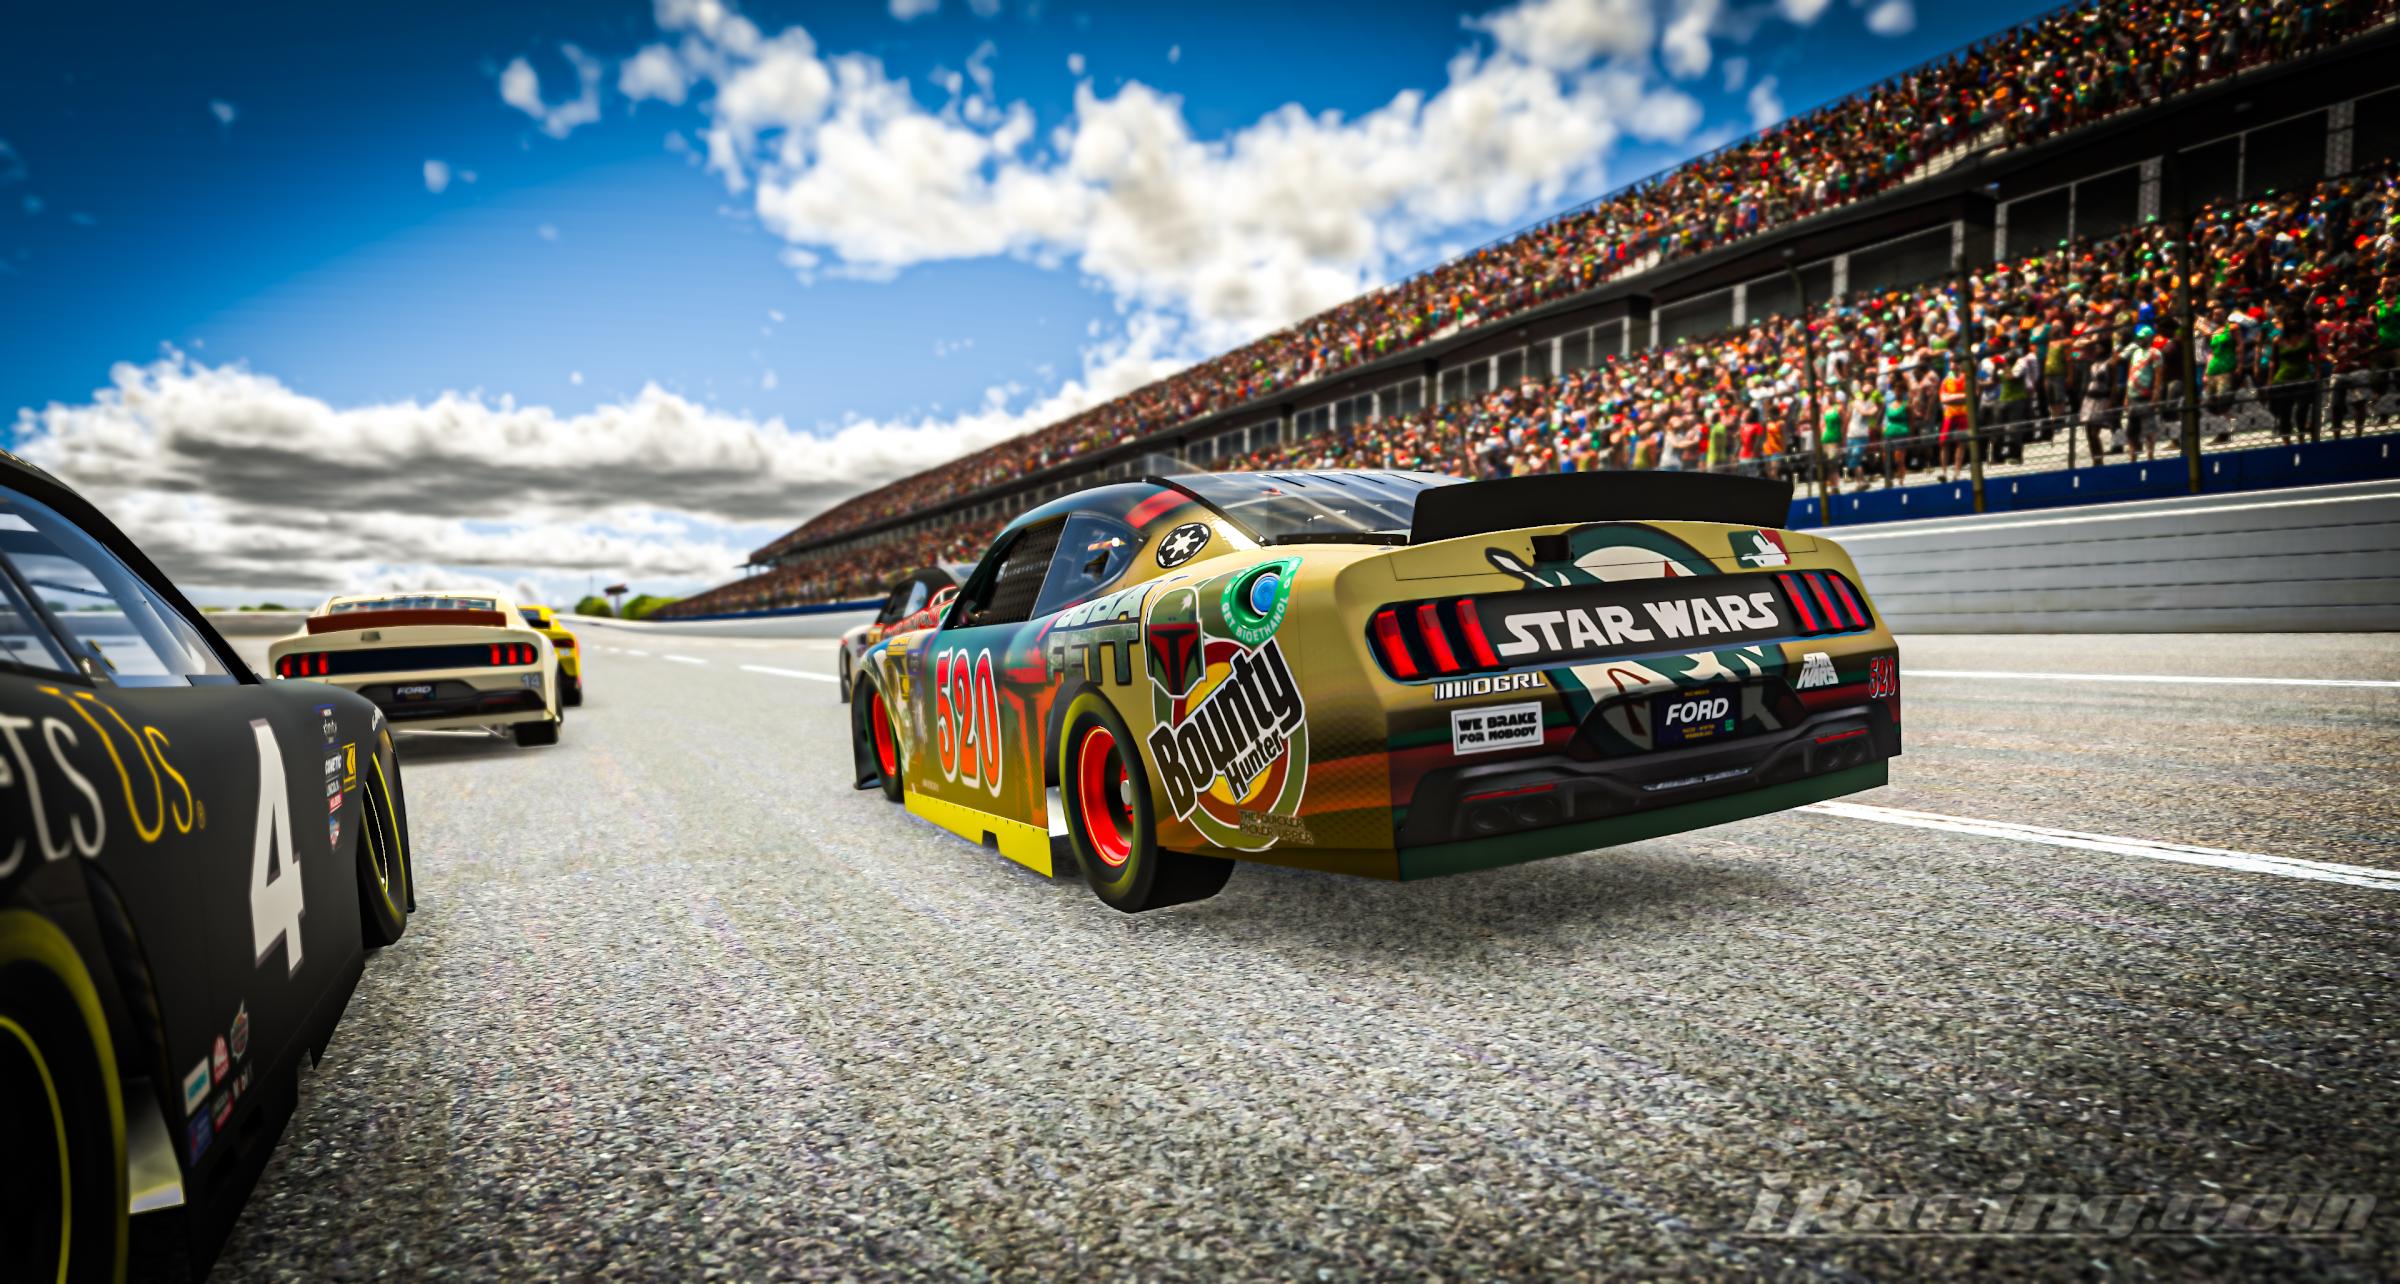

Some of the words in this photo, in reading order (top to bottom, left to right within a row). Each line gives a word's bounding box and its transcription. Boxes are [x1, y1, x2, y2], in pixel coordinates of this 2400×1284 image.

[1221, 602, 1236, 628] GET
[1235, 597, 1289, 642] BIOETHANOL
[1497, 609, 1654, 656] STAR
[1642, 591, 1779, 639] WARS
[1046, 622, 1140, 686] FETT
[397, 686, 432, 696] FORD
[1796, 667, 1839, 689] WARS
[1869, 656, 1896, 698] 520
[936, 647, 1003, 798] 520
[1147, 636, 1305, 822] Bounty
[1458, 718, 1482, 731] WE
[1487, 712, 1537, 729] BRAKE
[1665, 697, 1729, 726] FORD
[1459, 732, 1484, 745] FOR
[1488, 725, 1537, 741] NOBODY
[1223, 728, 1285, 803] Hunter
[1239, 810, 1257, 822] THE
[249, 717, 305, 981] 4
